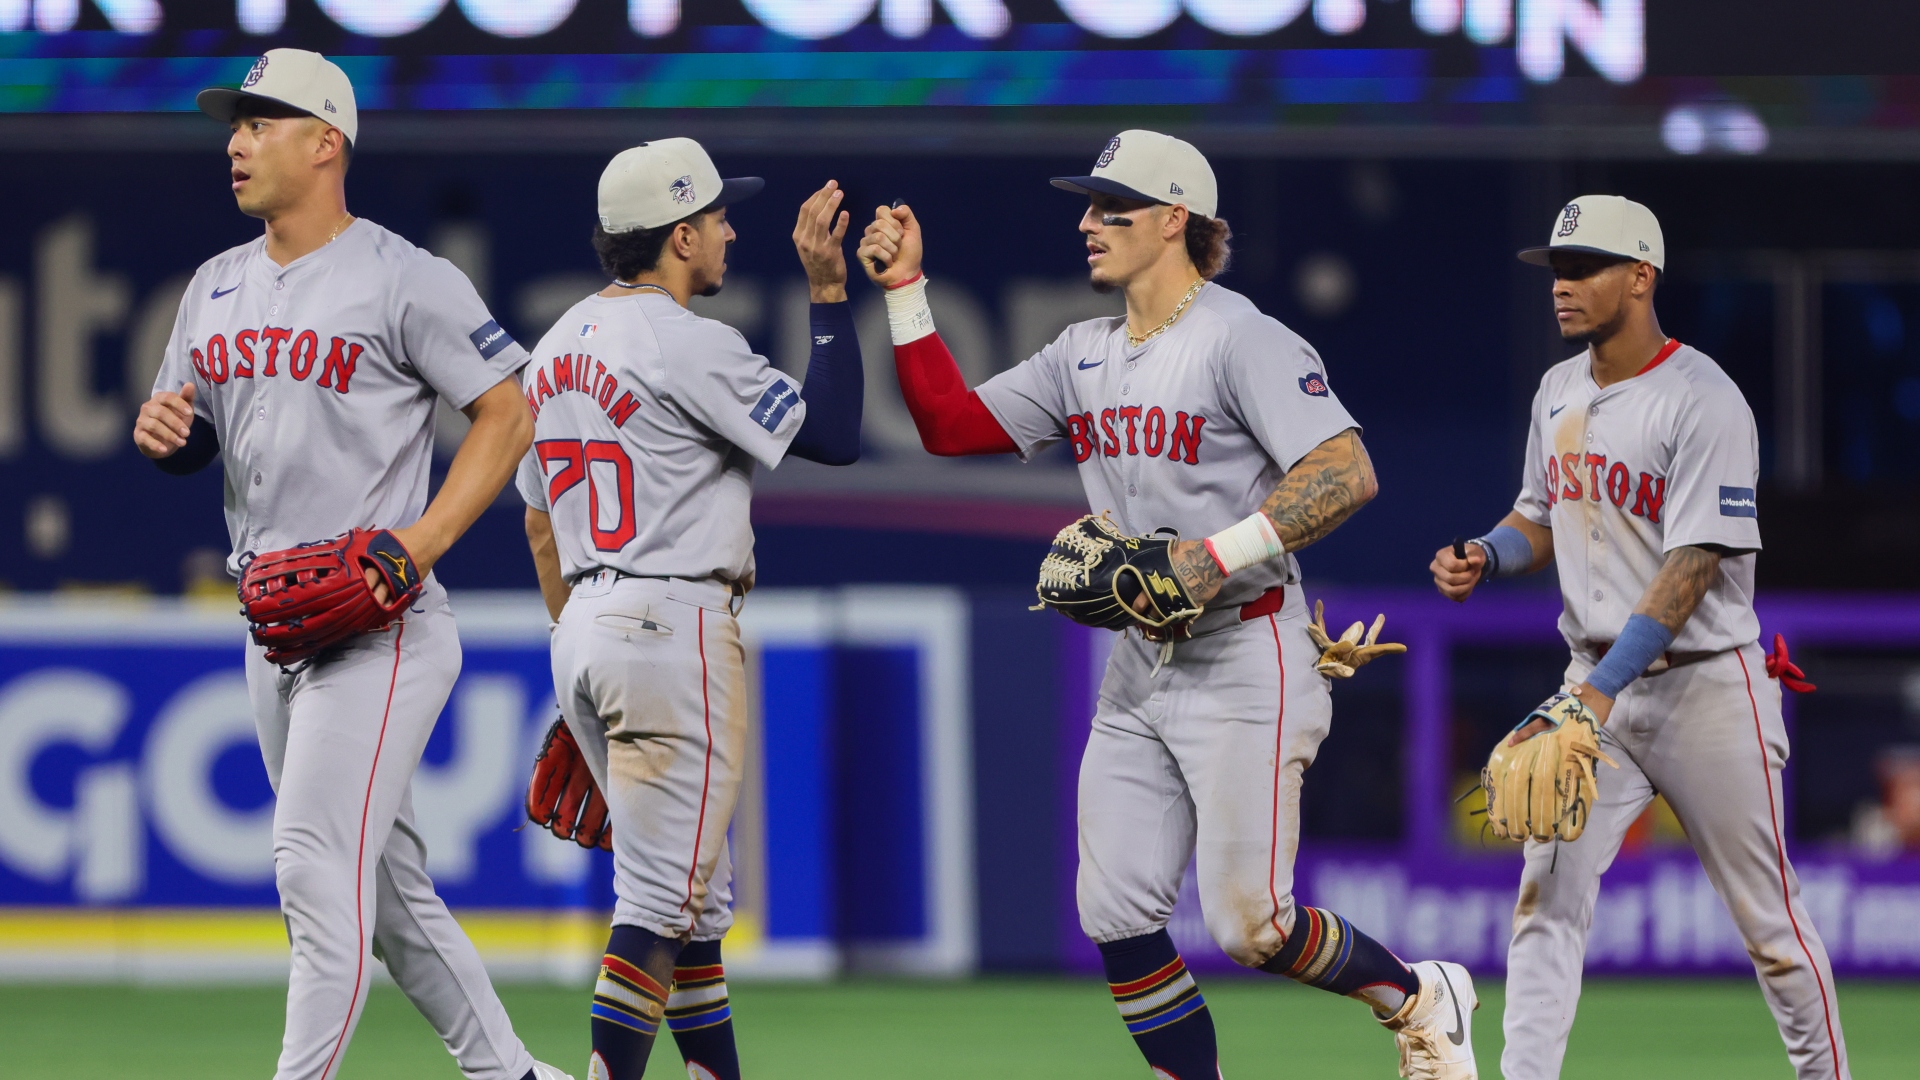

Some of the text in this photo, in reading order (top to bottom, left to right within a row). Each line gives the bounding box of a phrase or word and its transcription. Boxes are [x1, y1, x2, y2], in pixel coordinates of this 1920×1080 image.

[526, 353, 641, 429] HAMILTON
[534, 439, 637, 553] 70
[1545, 451, 1666, 524] OSTON
[1177, 561, 1198, 582] NOT
